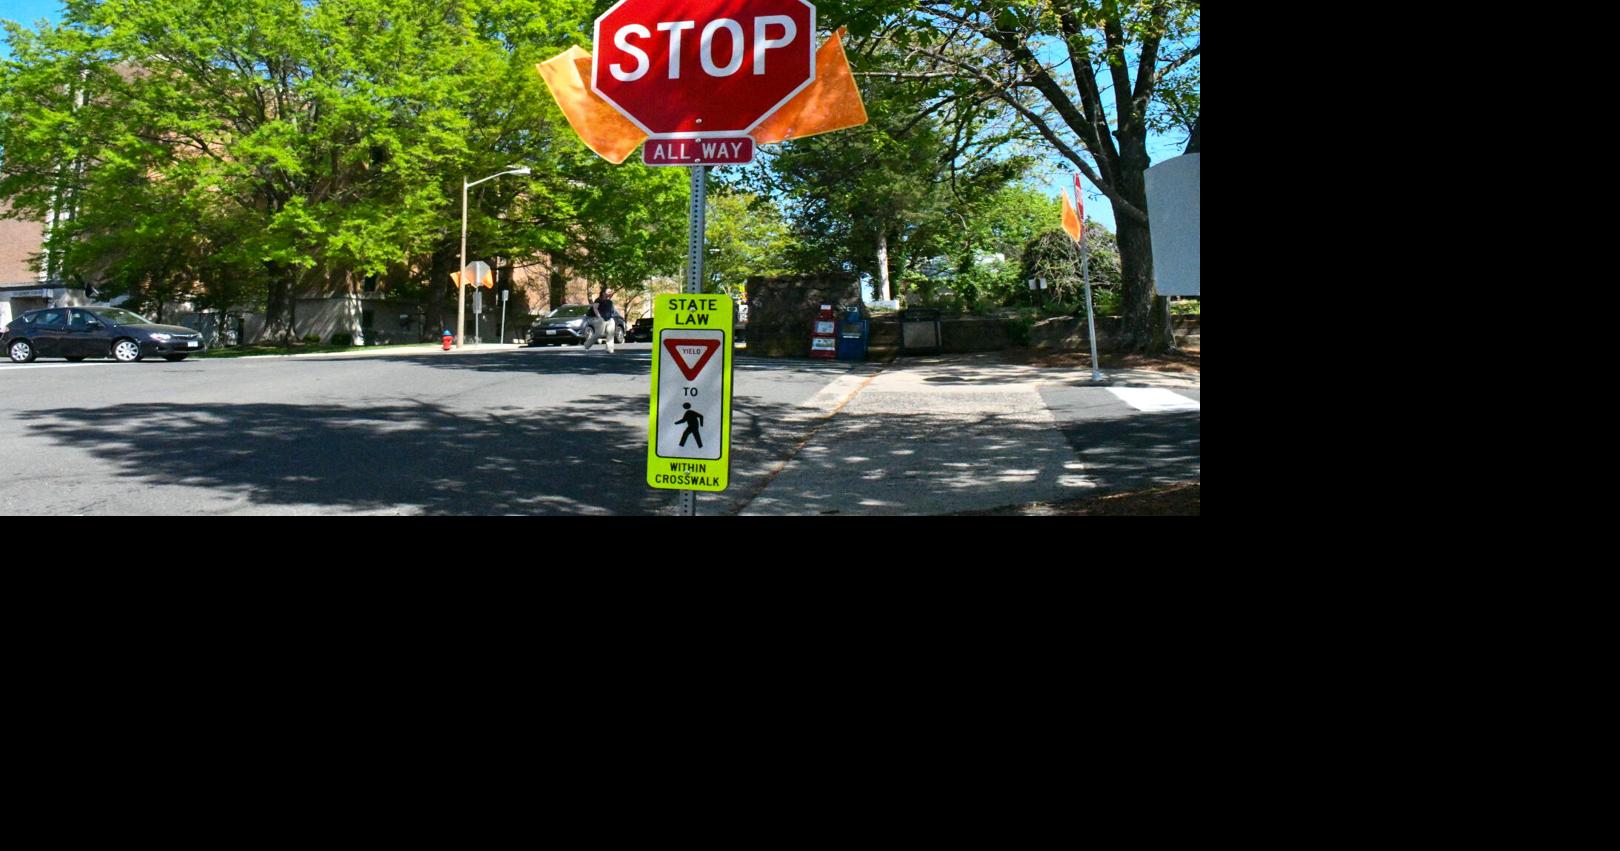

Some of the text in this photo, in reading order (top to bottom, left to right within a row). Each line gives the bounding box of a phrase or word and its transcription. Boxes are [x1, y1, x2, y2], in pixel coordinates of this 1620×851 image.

[609, 15, 798, 82] STOP
[653, 142, 743, 160] ALL WAY
[669, 299, 717, 311] STATE
[675, 314, 709, 325] LAW
[683, 387, 698, 396] TO
[670, 463, 706, 473] WITHIN
[655, 474, 720, 486] CROSSWALK
